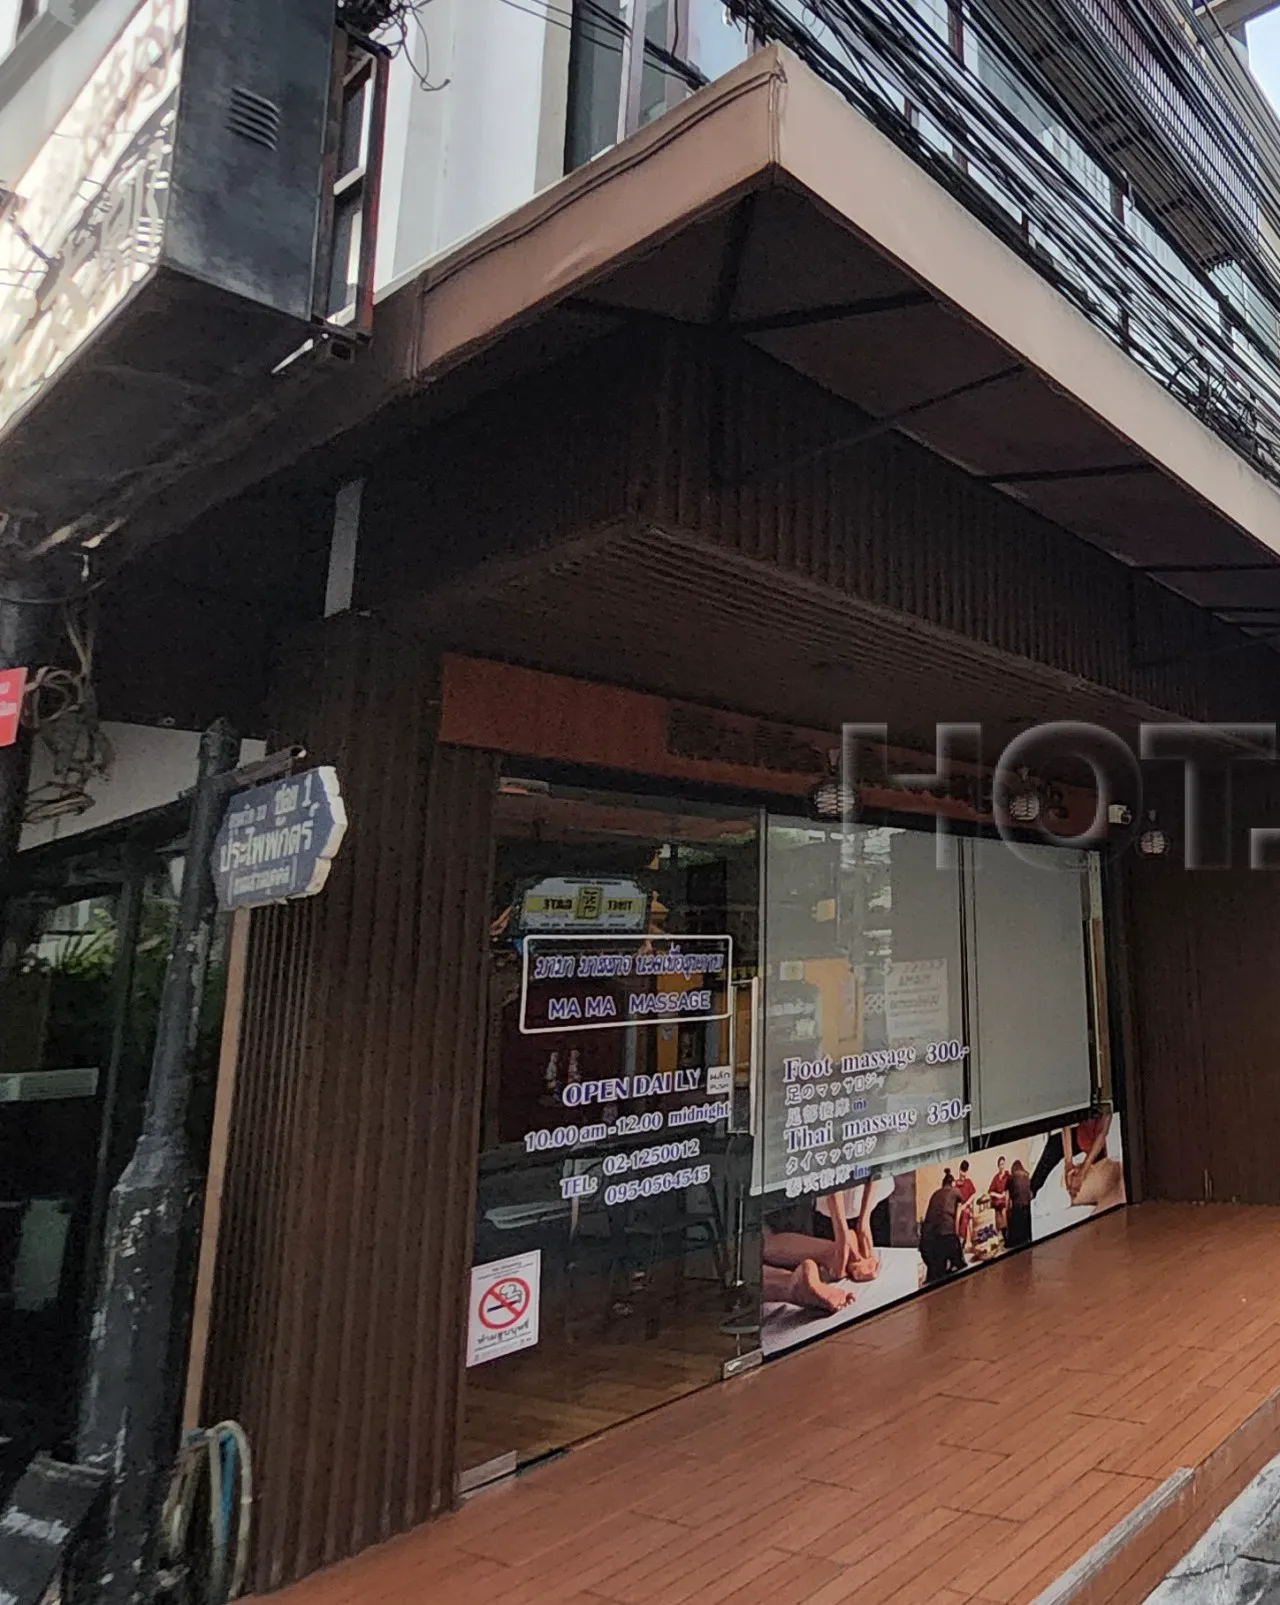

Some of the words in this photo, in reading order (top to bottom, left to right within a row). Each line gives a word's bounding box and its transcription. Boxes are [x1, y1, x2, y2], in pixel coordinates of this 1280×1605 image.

[548, 998, 581, 1020] MA
[585, 995, 616, 1018] MA
[629, 990, 712, 1014] MASSAGE
[782, 1057, 832, 1083] Foot
[841, 1045, 916, 1073] massage
[562, 1077, 629, 1106] OPEN
[524, 1125, 578, 1152] 10.00
[579, 1123, 606, 1143] am
[668, 1101, 731, 1127] midnight
[783, 1121, 834, 1154] Thai
[842, 1107, 917, 1139] massage
[603, 1138, 700, 1175] 02-1250012
[560, 1174, 598, 1199] TEL:
